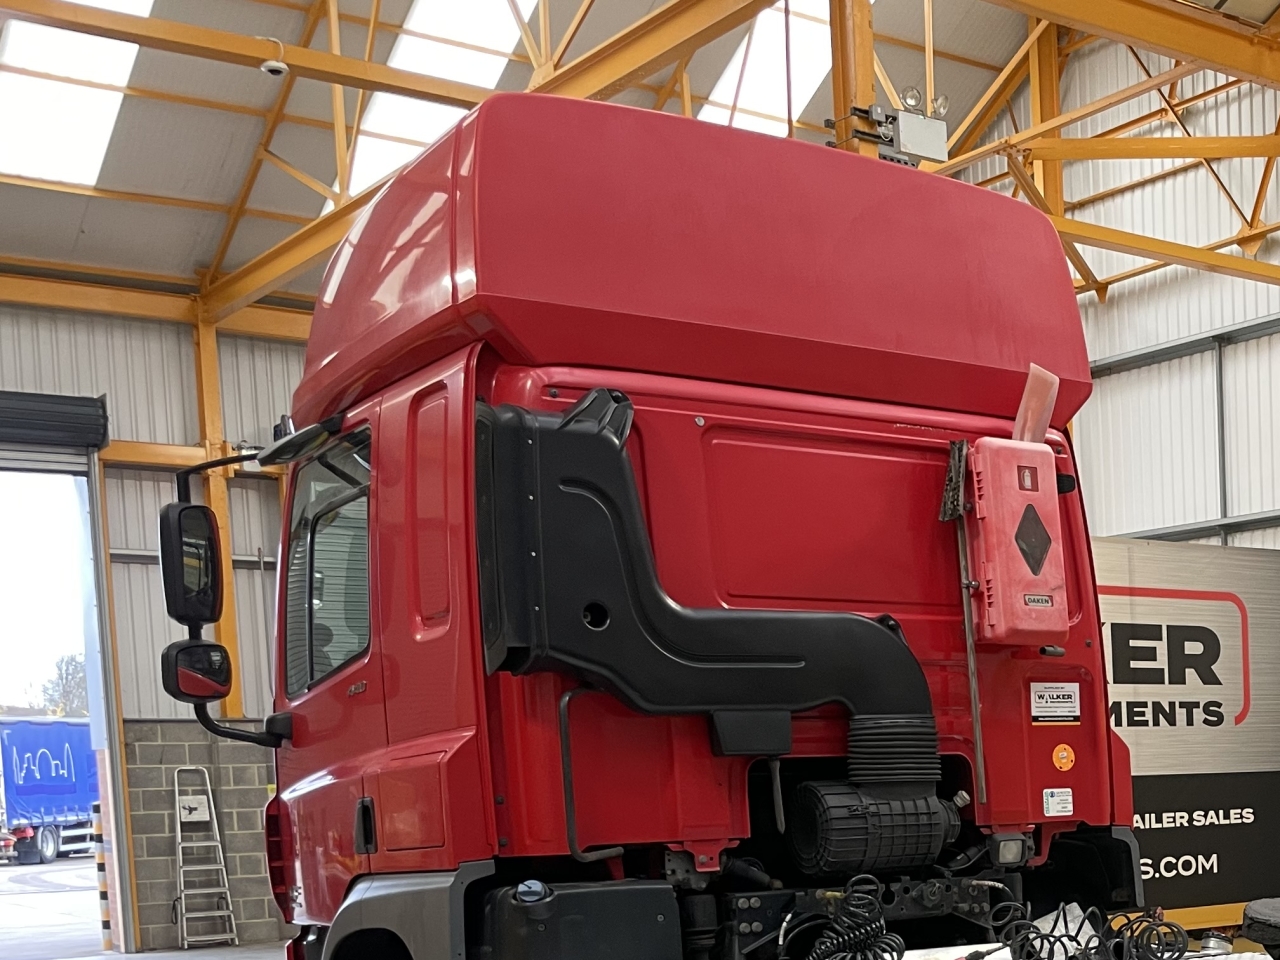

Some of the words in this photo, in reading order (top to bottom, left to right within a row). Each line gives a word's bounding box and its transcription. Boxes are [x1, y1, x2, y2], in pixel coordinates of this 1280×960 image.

[1101, 622, 1223, 685] ER
[1037, 694, 1073, 704] WALKER
[1192, 808, 1255, 826] SALES
